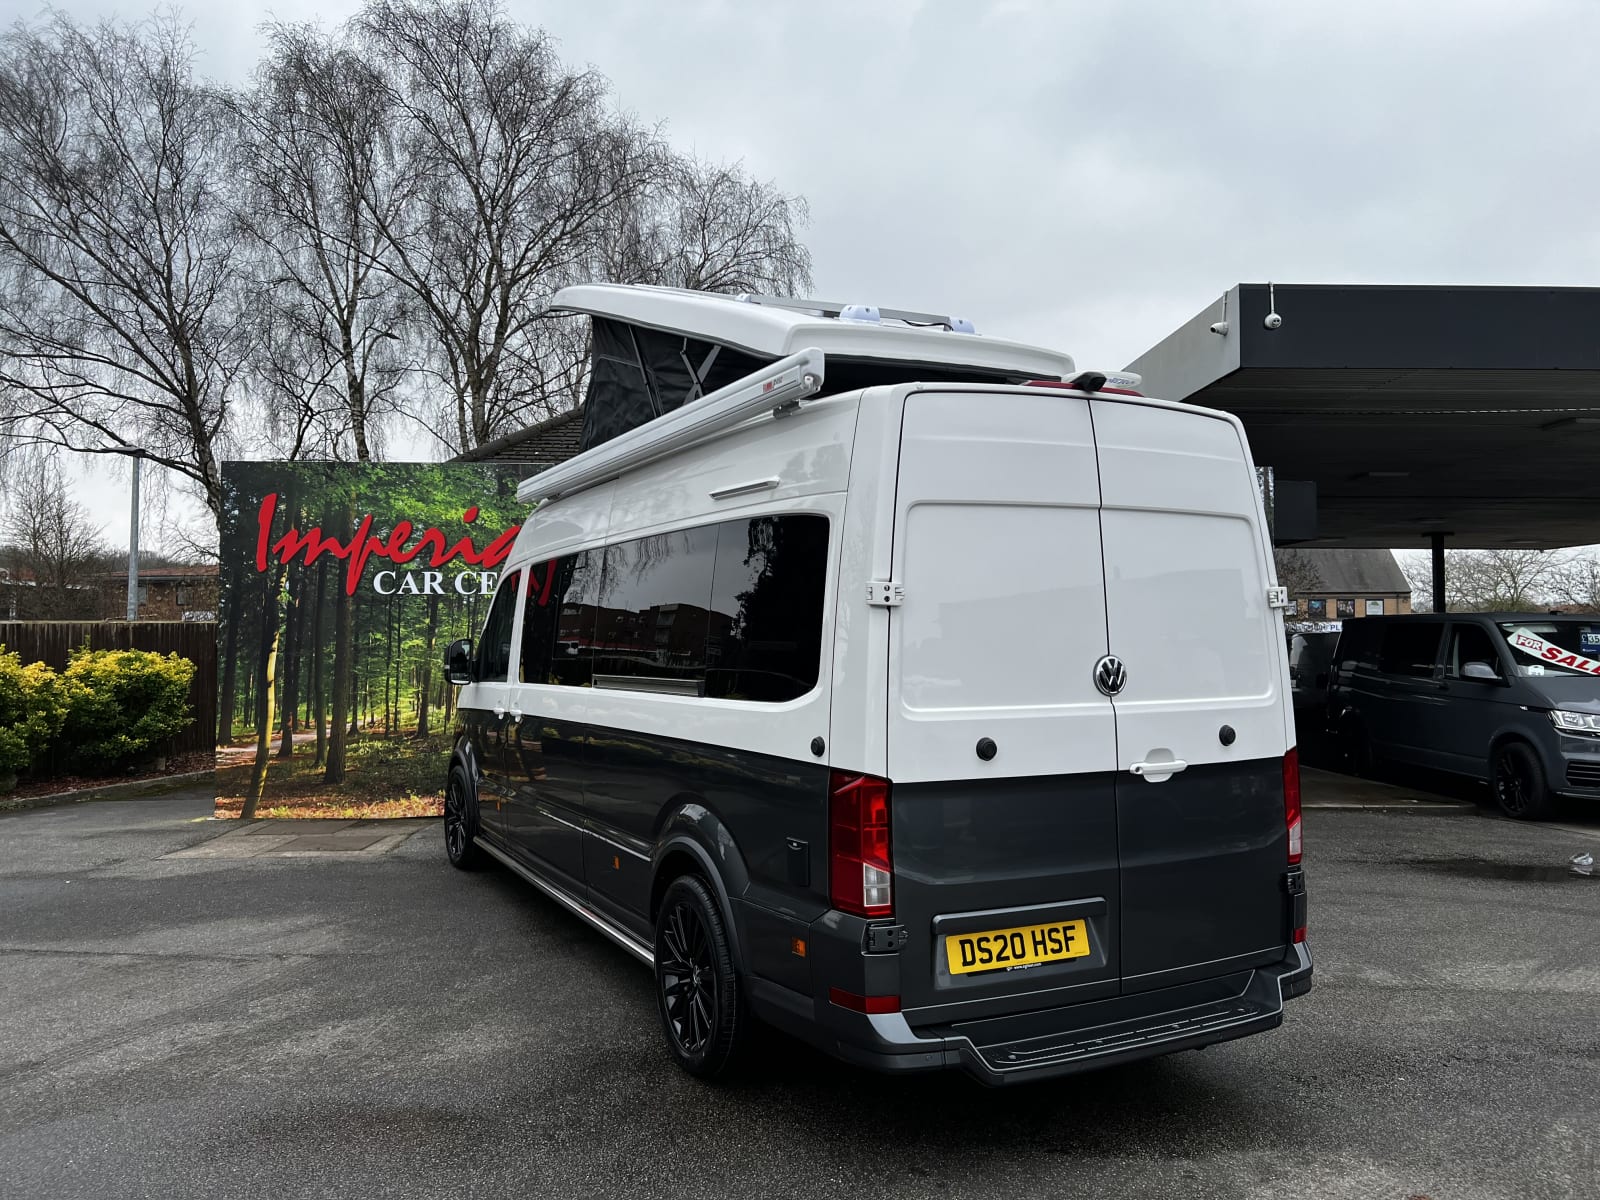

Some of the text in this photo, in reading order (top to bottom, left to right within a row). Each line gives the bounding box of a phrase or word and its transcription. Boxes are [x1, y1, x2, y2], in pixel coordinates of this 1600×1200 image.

[373, 571, 446, 595] CAR
[1518, 636, 1542, 650] FOR
[959, 925, 1076, 967] DS20 HSF
